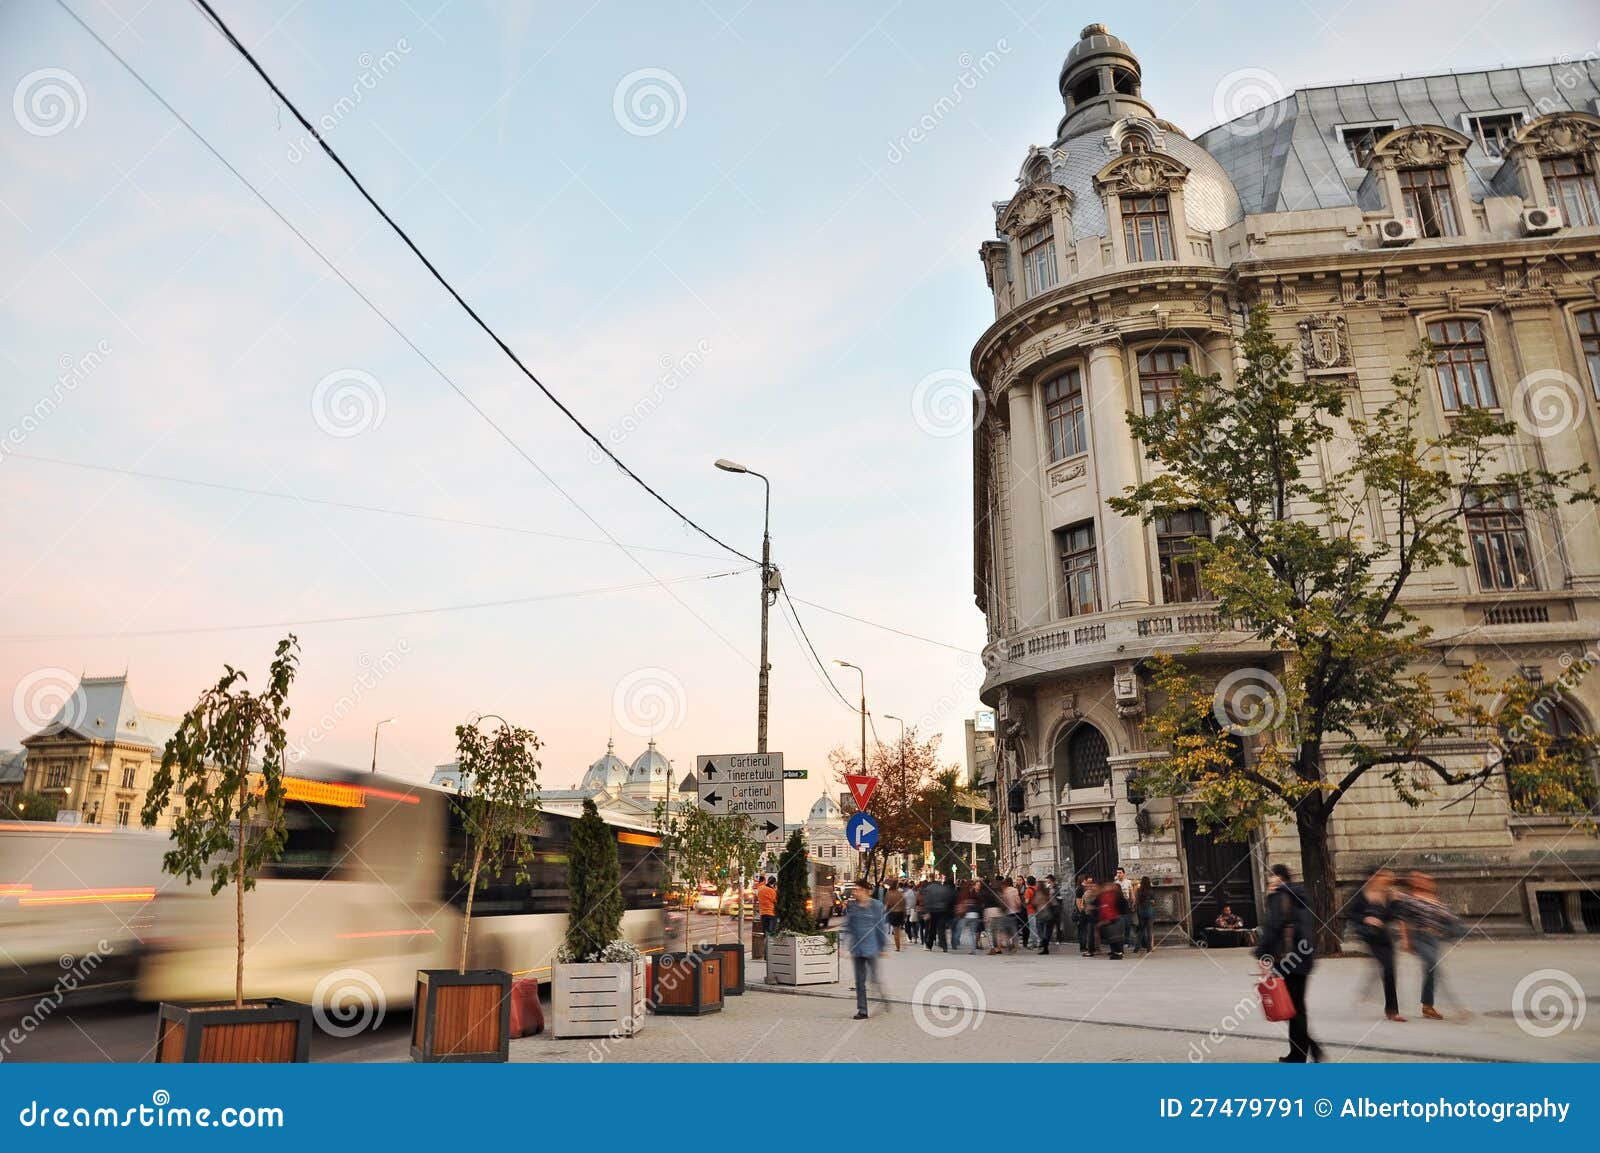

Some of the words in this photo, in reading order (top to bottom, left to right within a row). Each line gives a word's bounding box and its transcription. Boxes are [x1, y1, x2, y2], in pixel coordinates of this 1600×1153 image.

[730, 755, 770, 767] Cartierul
[727, 768, 774, 780] Tineretului
[732, 785, 771, 797] Cartierul
[727, 799, 777, 811] Pantelimon
